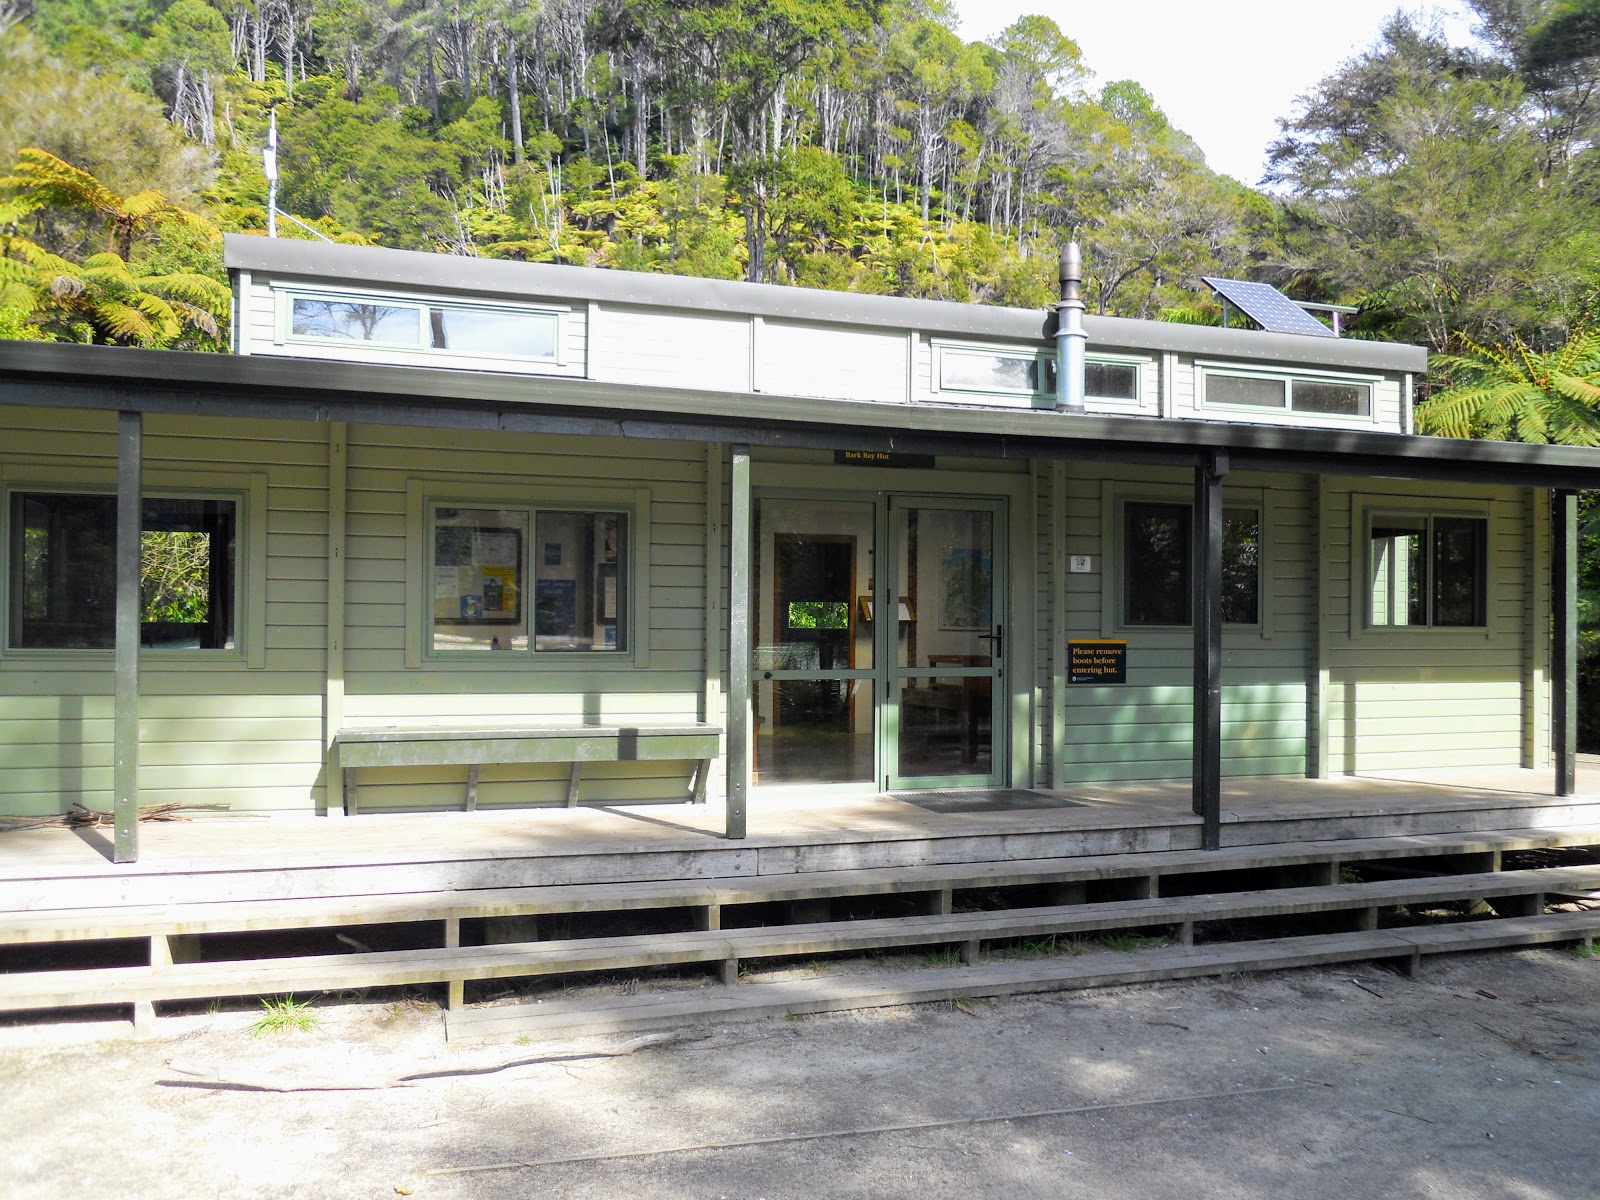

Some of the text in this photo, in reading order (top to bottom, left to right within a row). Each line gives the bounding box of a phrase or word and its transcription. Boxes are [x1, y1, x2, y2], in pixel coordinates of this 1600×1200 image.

[845, 451, 861, 459] Bark
[863, 452, 875, 460] Bay
[1072, 666, 1118, 675] entering hut.
